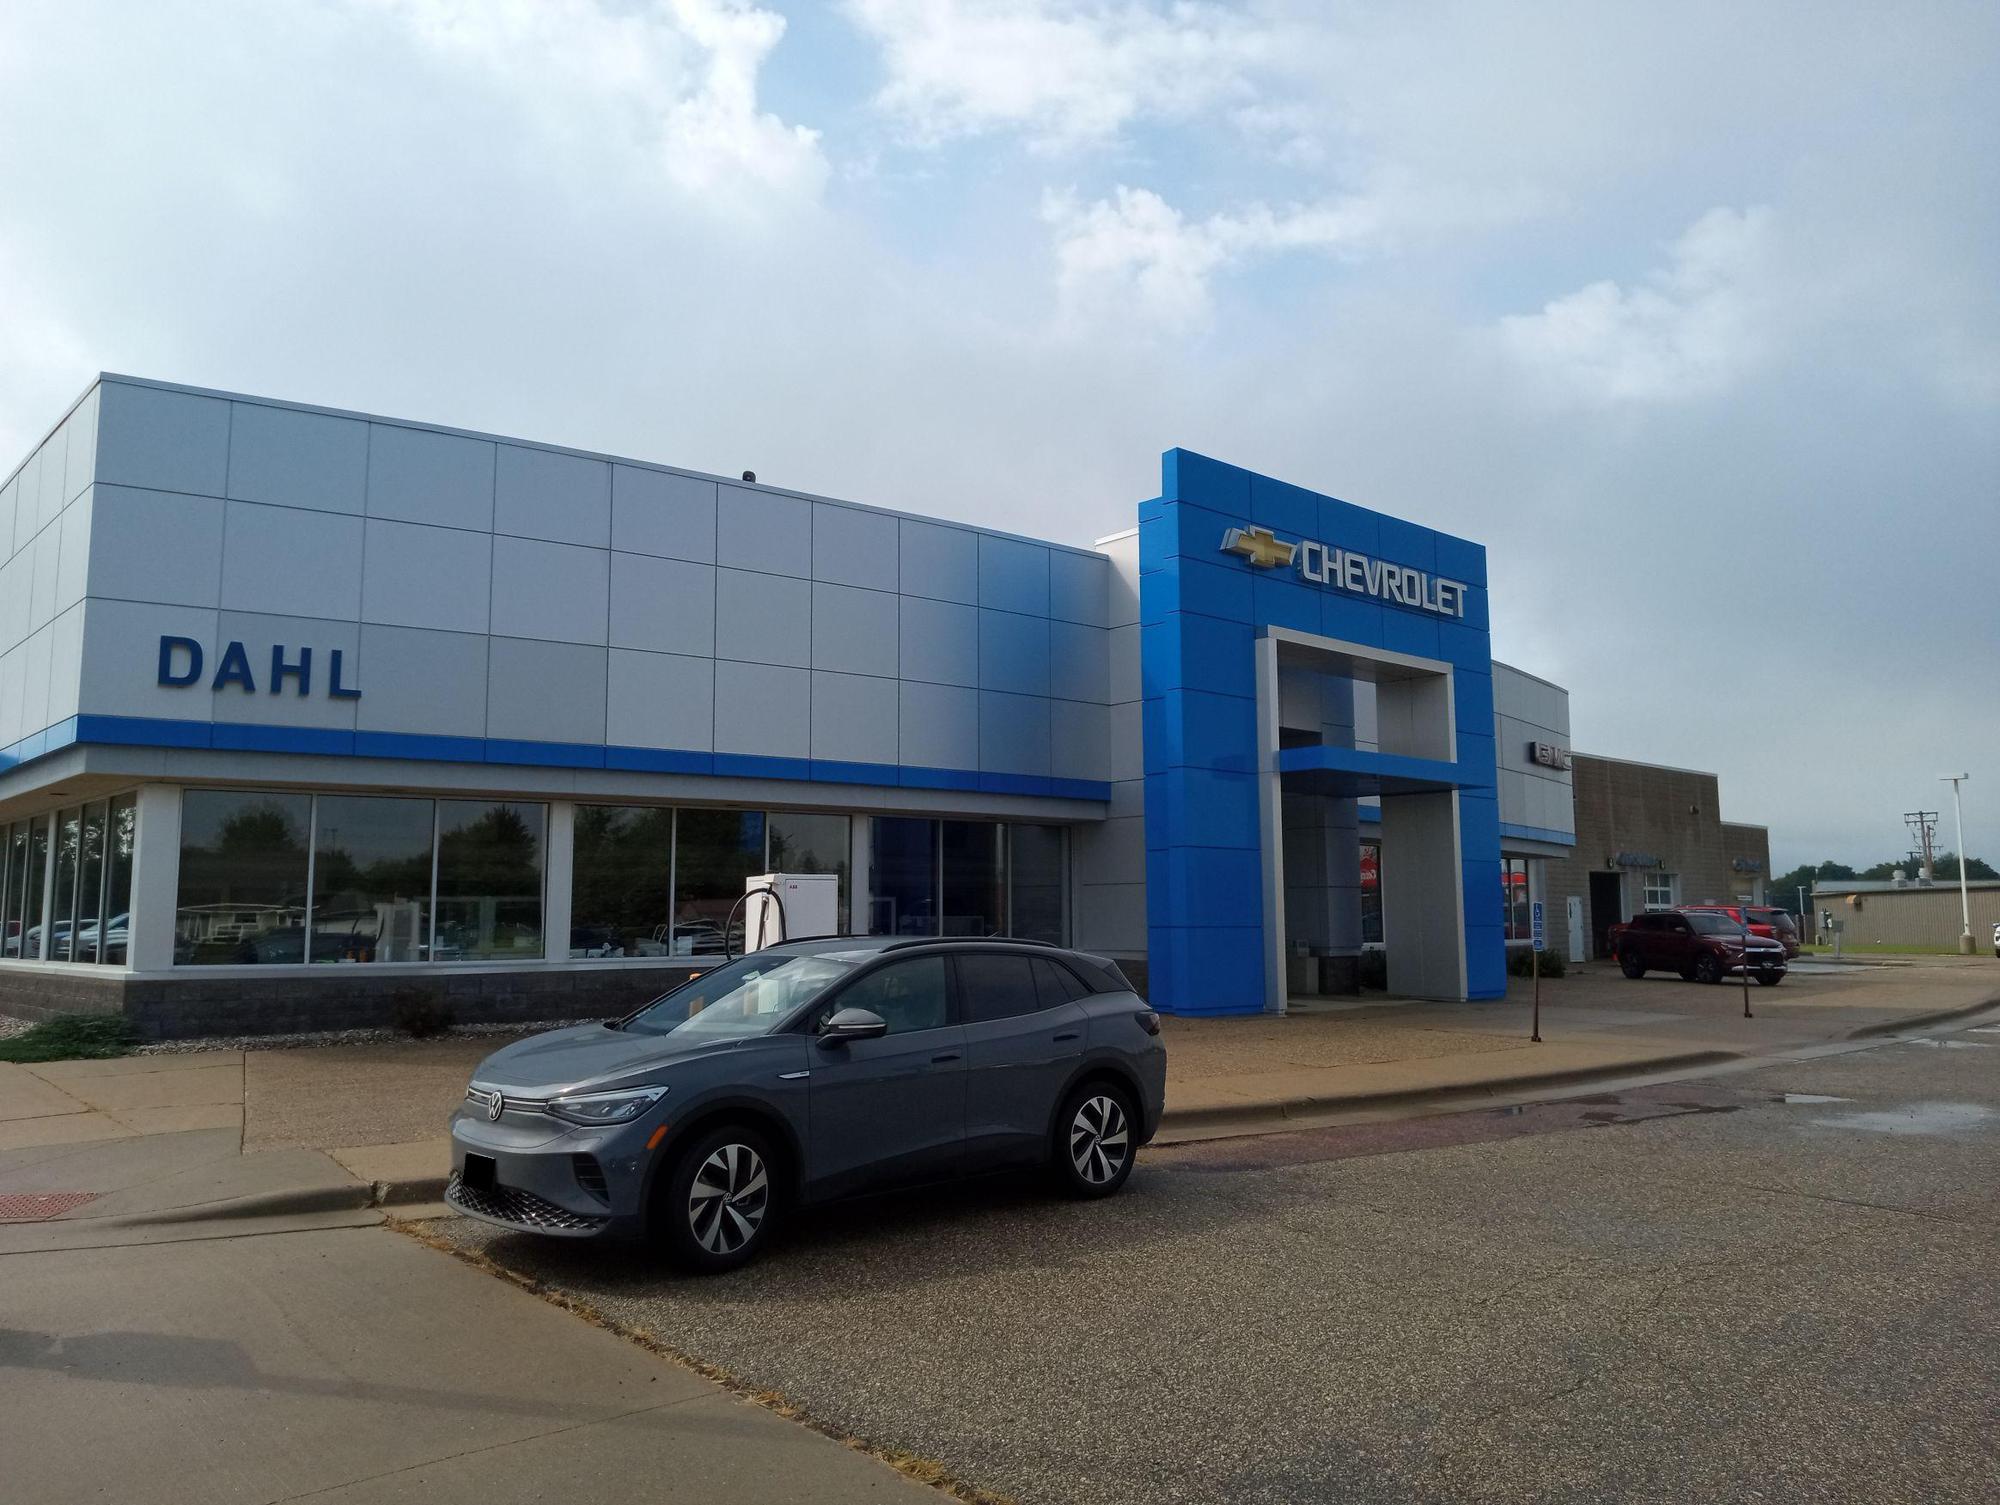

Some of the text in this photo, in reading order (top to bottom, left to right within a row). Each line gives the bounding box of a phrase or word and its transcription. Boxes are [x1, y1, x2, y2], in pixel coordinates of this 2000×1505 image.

[1302, 540, 1468, 618] CHEVROLET
[158, 635, 362, 698] DAHL
[1534, 742, 1572, 770] GMC
